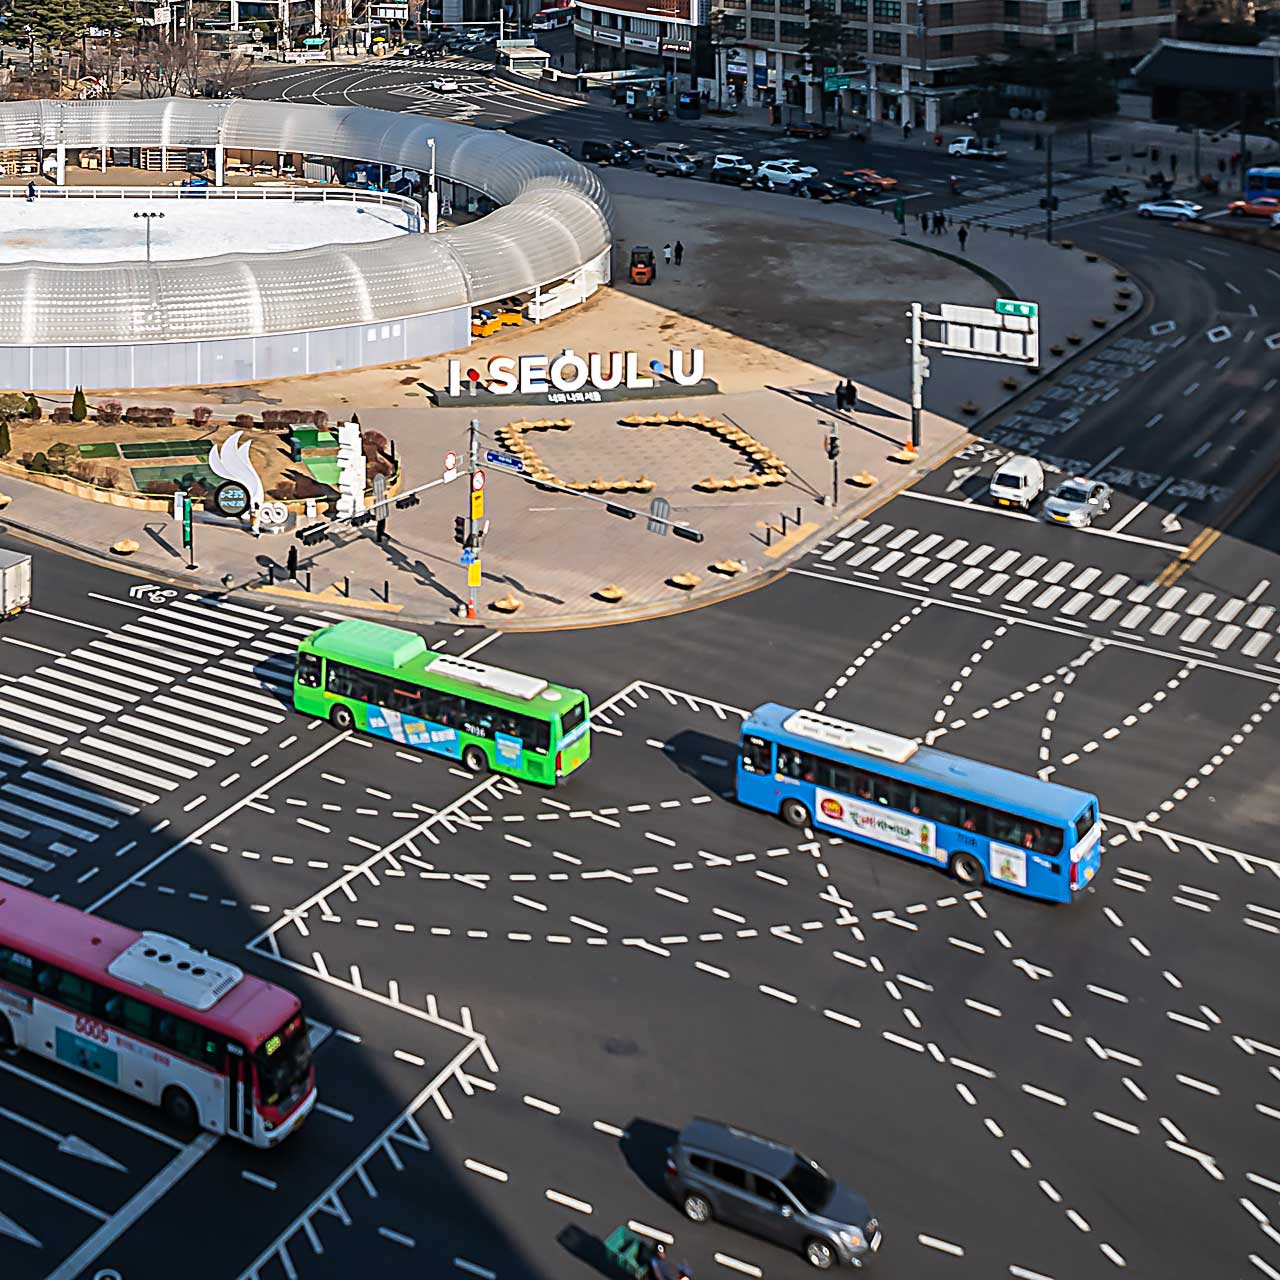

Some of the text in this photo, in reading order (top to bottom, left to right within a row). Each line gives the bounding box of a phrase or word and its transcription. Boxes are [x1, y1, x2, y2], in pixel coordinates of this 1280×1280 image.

[448, 348, 705, 397] I SEOUL U
